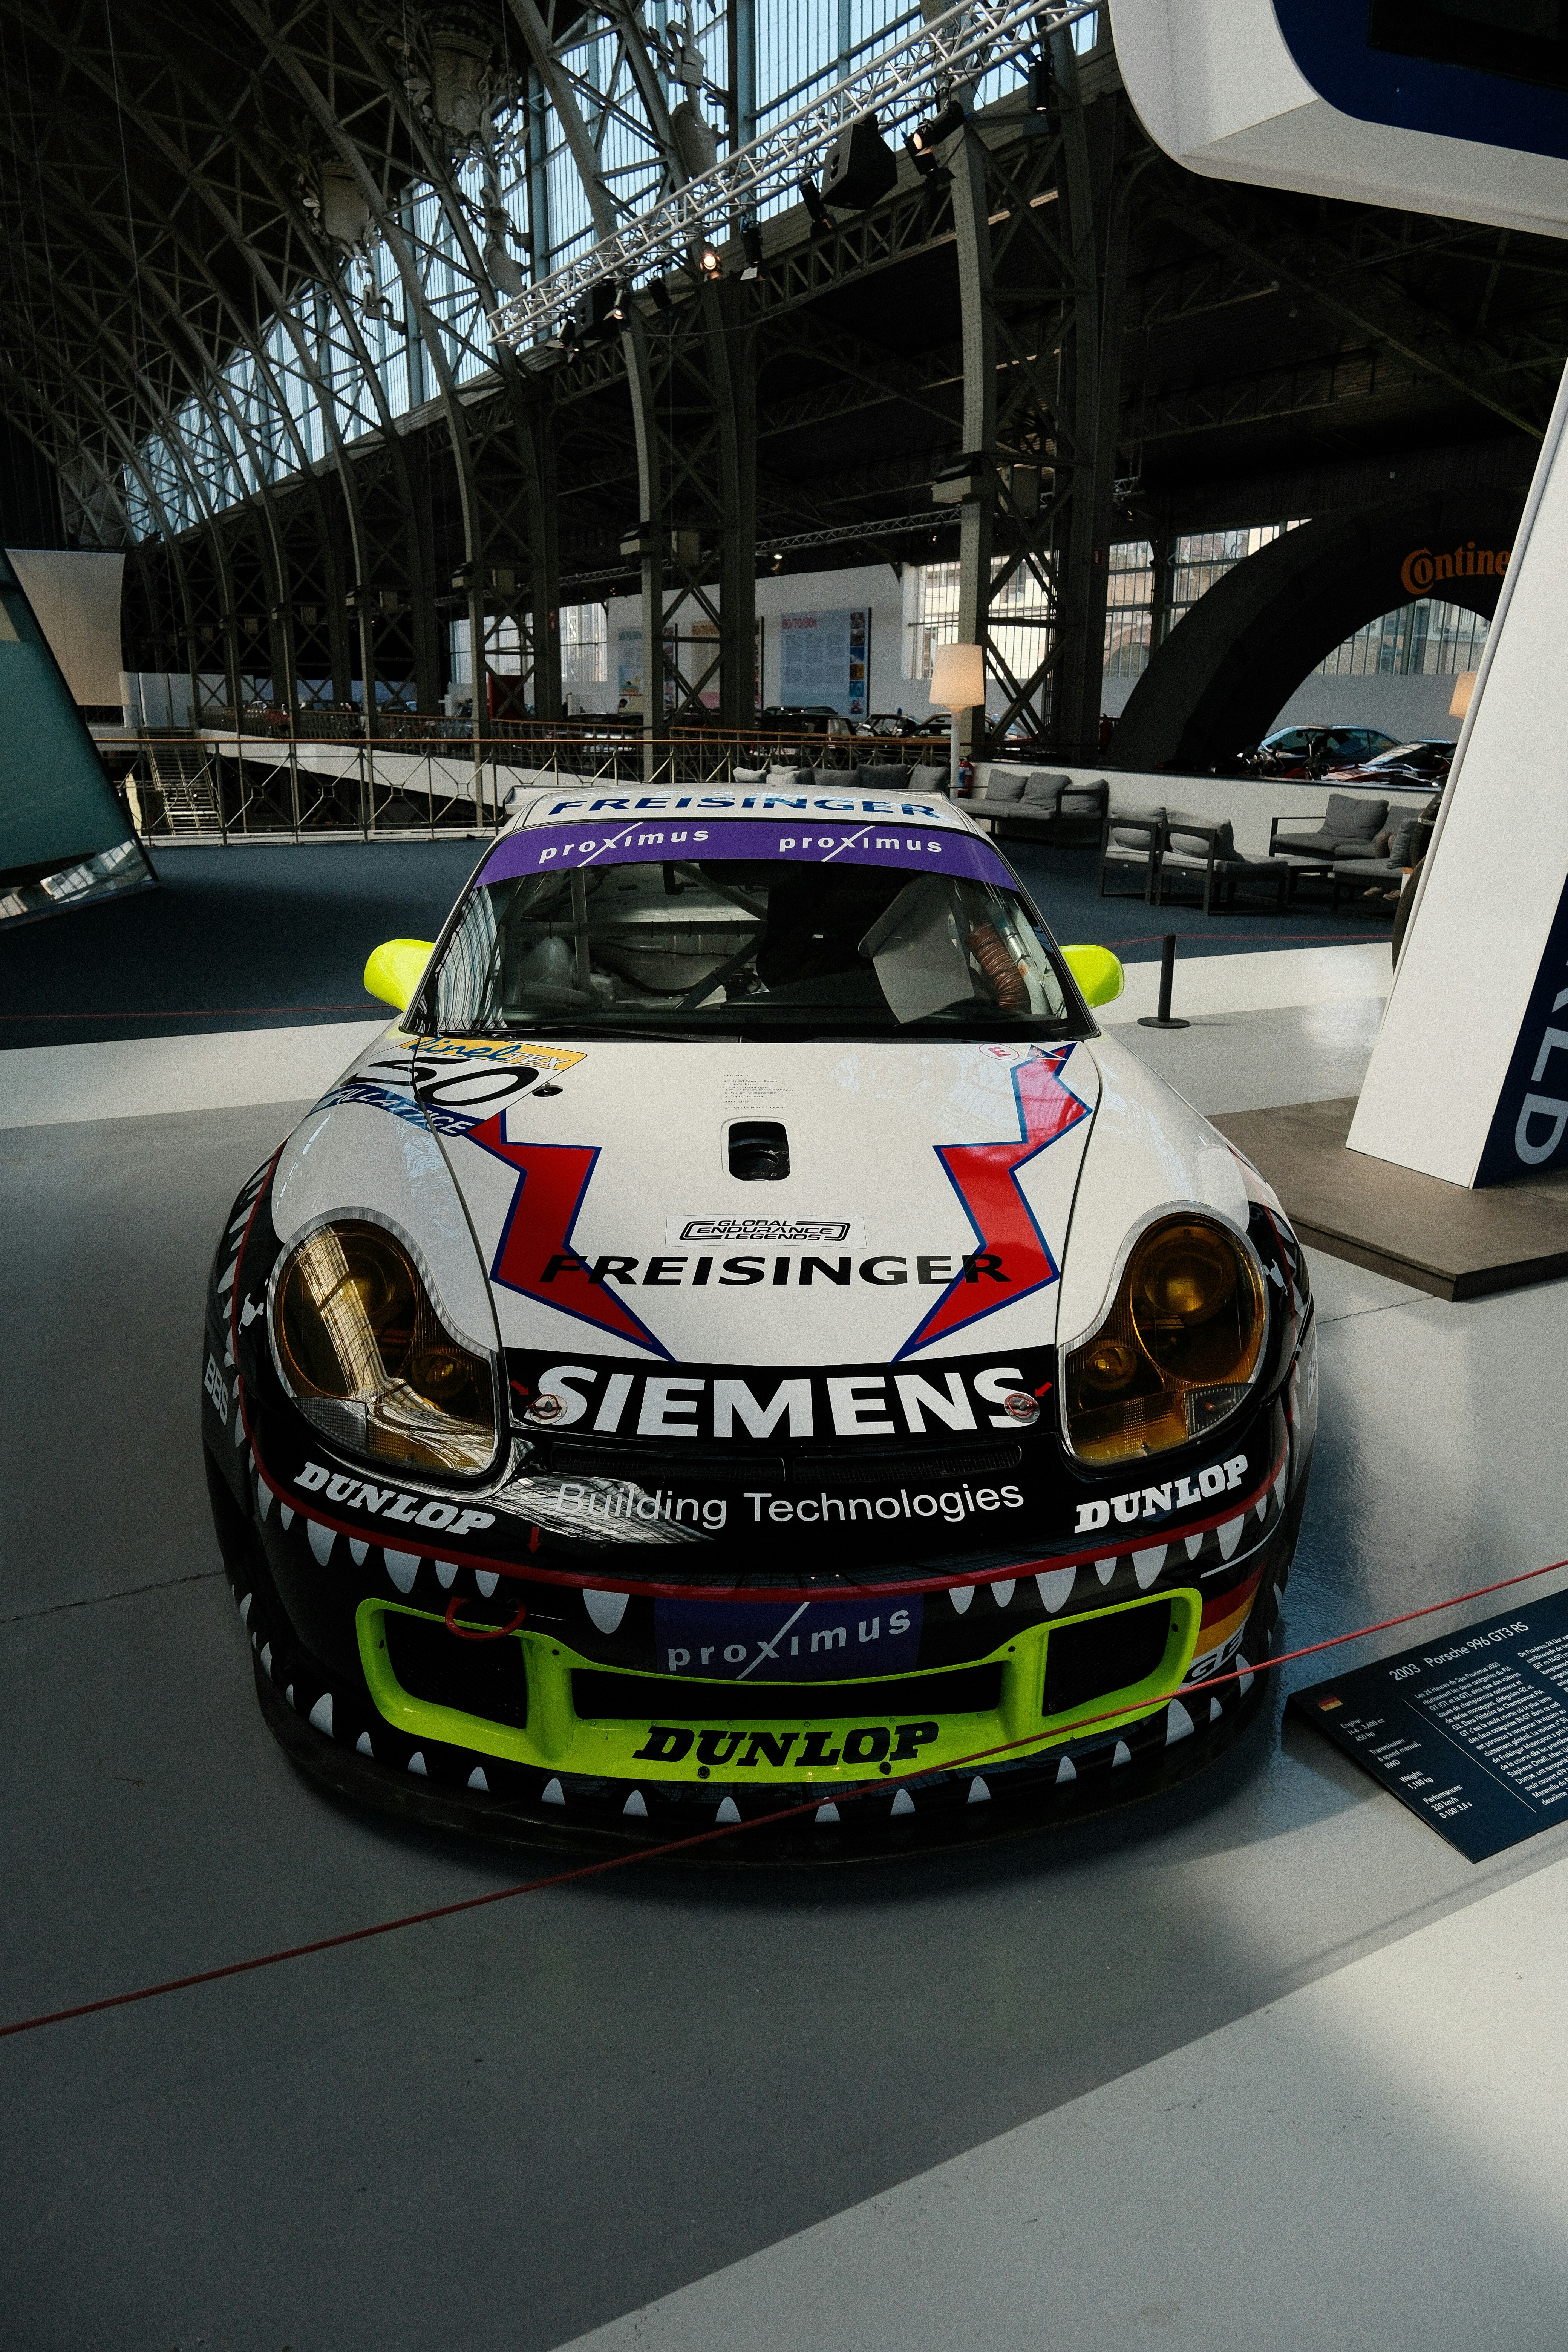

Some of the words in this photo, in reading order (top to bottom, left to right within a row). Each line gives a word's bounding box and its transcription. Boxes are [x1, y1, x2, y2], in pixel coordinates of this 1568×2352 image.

[1094, 551, 1099, 563] 1
[1401, 542, 1510, 594] Contine
[548, 797, 942, 818] FREISINGER
[539, 823, 709, 867] proximus
[779, 831, 942, 858] proximus
[1514, 961, 1568, 1164] LD
[539, 1254, 1012, 1285] FREISINGER
[204, 1352, 228, 1426] BBS
[524, 1366, 1039, 1438] SIEMENS
[294, 1462, 494, 1536] DUNLOP
[1074, 1455, 1248, 1534] DUNLOP
[554, 1483, 727, 1530] Building
[743, 1484, 1024, 1522] Technologies
[668, 1602, 910, 1680] proximus
[1389, 1663, 1421, 1681] 2003
[1423, 1647, 1470, 1667] Porsche
[1466, 1636, 1491, 1650] 996
[1488, 1627, 1514, 1642] GT3
[1509, 1622, 1529, 1633] RS
[1524, 1644, 1548, 1654] Proximus
[1526, 1649, 1556, 1663] combineerde
[1547, 1654, 1565, 1663] N-GT)
[1501, 1672, 1521, 1682] voitures
[1423, 1690, 1453, 1705] réunissaient
[1471, 1673, 1497, 1685] catégories
[1460, 1692, 1494, 1708] championnats
[1492, 1683, 1517, 1695] nationaux
[1452, 1712, 1468, 1721] séries
[1495, 1690, 1521, 1703] désignées
[1502, 1693, 1536, 1709] Championnat
[1486, 1717, 1501, 1726] seule
[1499, 1711, 1517, 1720] course
[1491, 1720, 1517, 1733] catégories
[1514, 1712, 1531, 1723] (N-GT
[1484, 1734, 1508, 1747] parvenue
[1511, 1721, 1537, 1735] remporter
[1540, 1712, 1560, 1722] victoire
[1484, 1742, 1513, 1756] classement
[1537, 1723, 1556, 1733] voiture
[631, 1721, 939, 1767] DUNLOP
[1382, 1749, 1400, 1760] speed
[1399, 1741, 1421, 1753] manual,
[1498, 1747, 1525, 1760] Freisinger
[1522, 1734, 1553, 1749] Motorsport
[1384, 1759, 1400, 1769] RWD
[1507, 1764, 1533, 1777] Stéphane
[1547, 1750, 1563, 1758] Marc
[1513, 1755, 1531, 1764] course
[1544, 1757, 1568, 1771] remporté
[1398, 1771, 1423, 1782] Weight:
[1407, 1779, 1425, 1789] 1,150
[1525, 1782, 1539, 1791] avoir
[1538, 1773, 1559, 1785] couvert
[1423, 1785, 1463, 1804] Performances:
[1531, 1784, 1559, 1798] Maranello
[1430, 1802, 1444, 1811] 320
[1441, 1796, 1459, 1806] km/h
[1439, 1807, 1459, 1818] 0-100:
